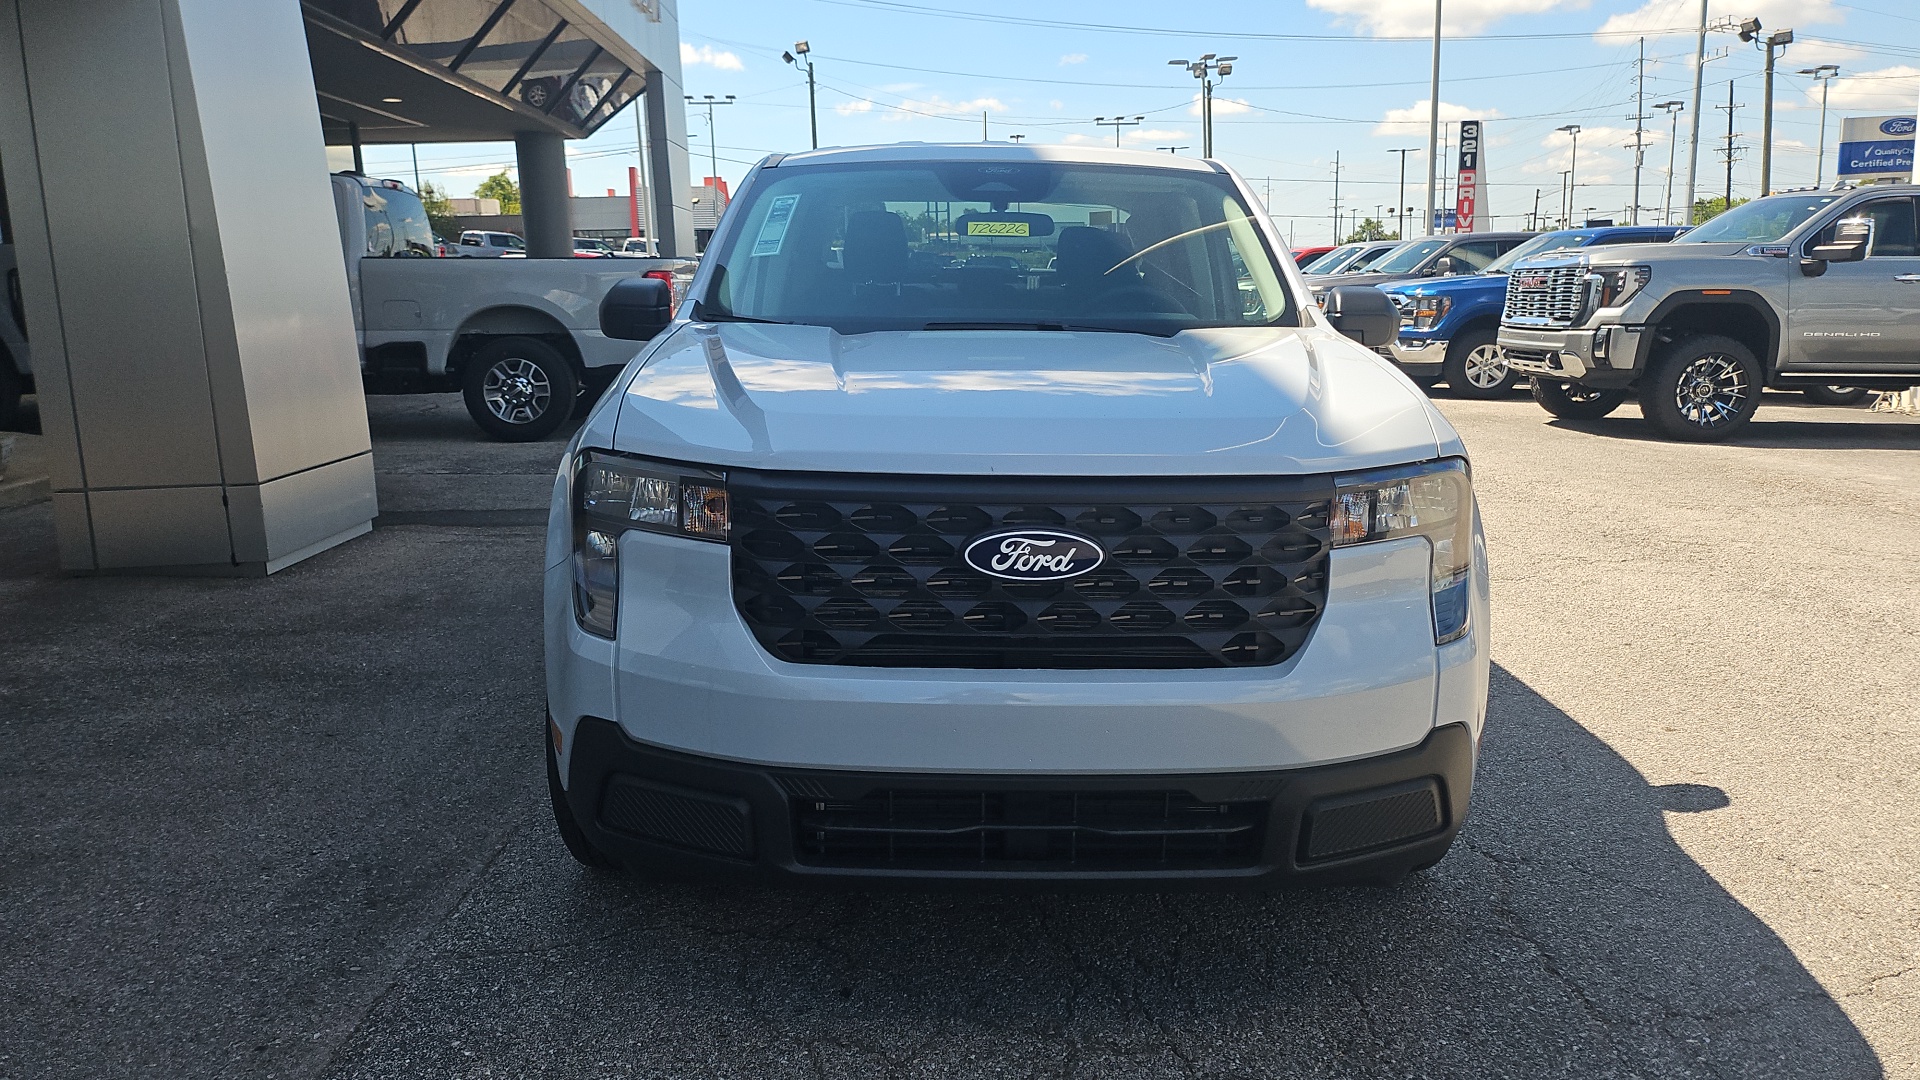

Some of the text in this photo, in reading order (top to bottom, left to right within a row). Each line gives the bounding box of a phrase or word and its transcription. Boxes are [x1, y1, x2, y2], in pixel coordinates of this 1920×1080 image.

[1889, 121, 1914, 132] Ford
[1461, 125, 1478, 167] 321
[1851, 159, 1893, 168] Certified
[971, 223, 1027, 235] T26226
[991, 538, 1076, 572] Ford
